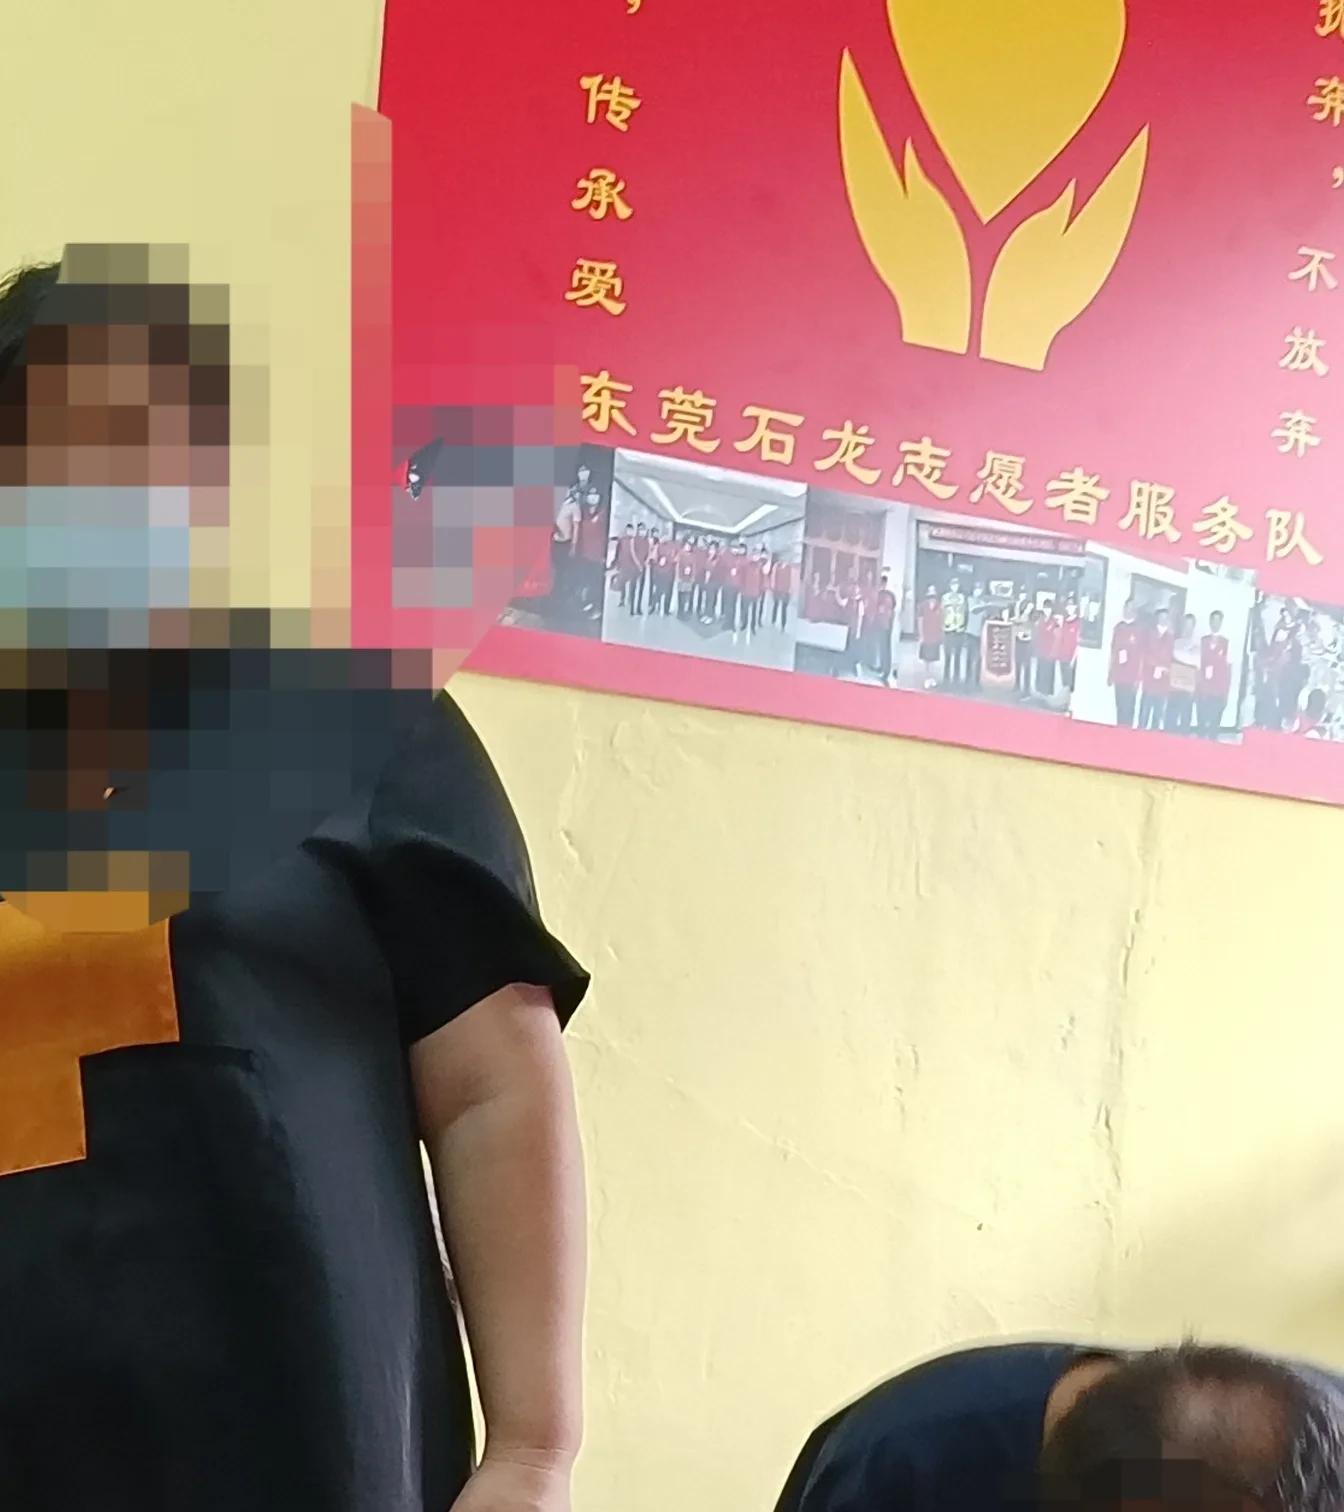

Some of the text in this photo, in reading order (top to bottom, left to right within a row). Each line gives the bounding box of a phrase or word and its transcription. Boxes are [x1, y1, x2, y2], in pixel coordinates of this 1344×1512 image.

[578, 369, 1324, 566] 东莞石龙志愿者服务队
